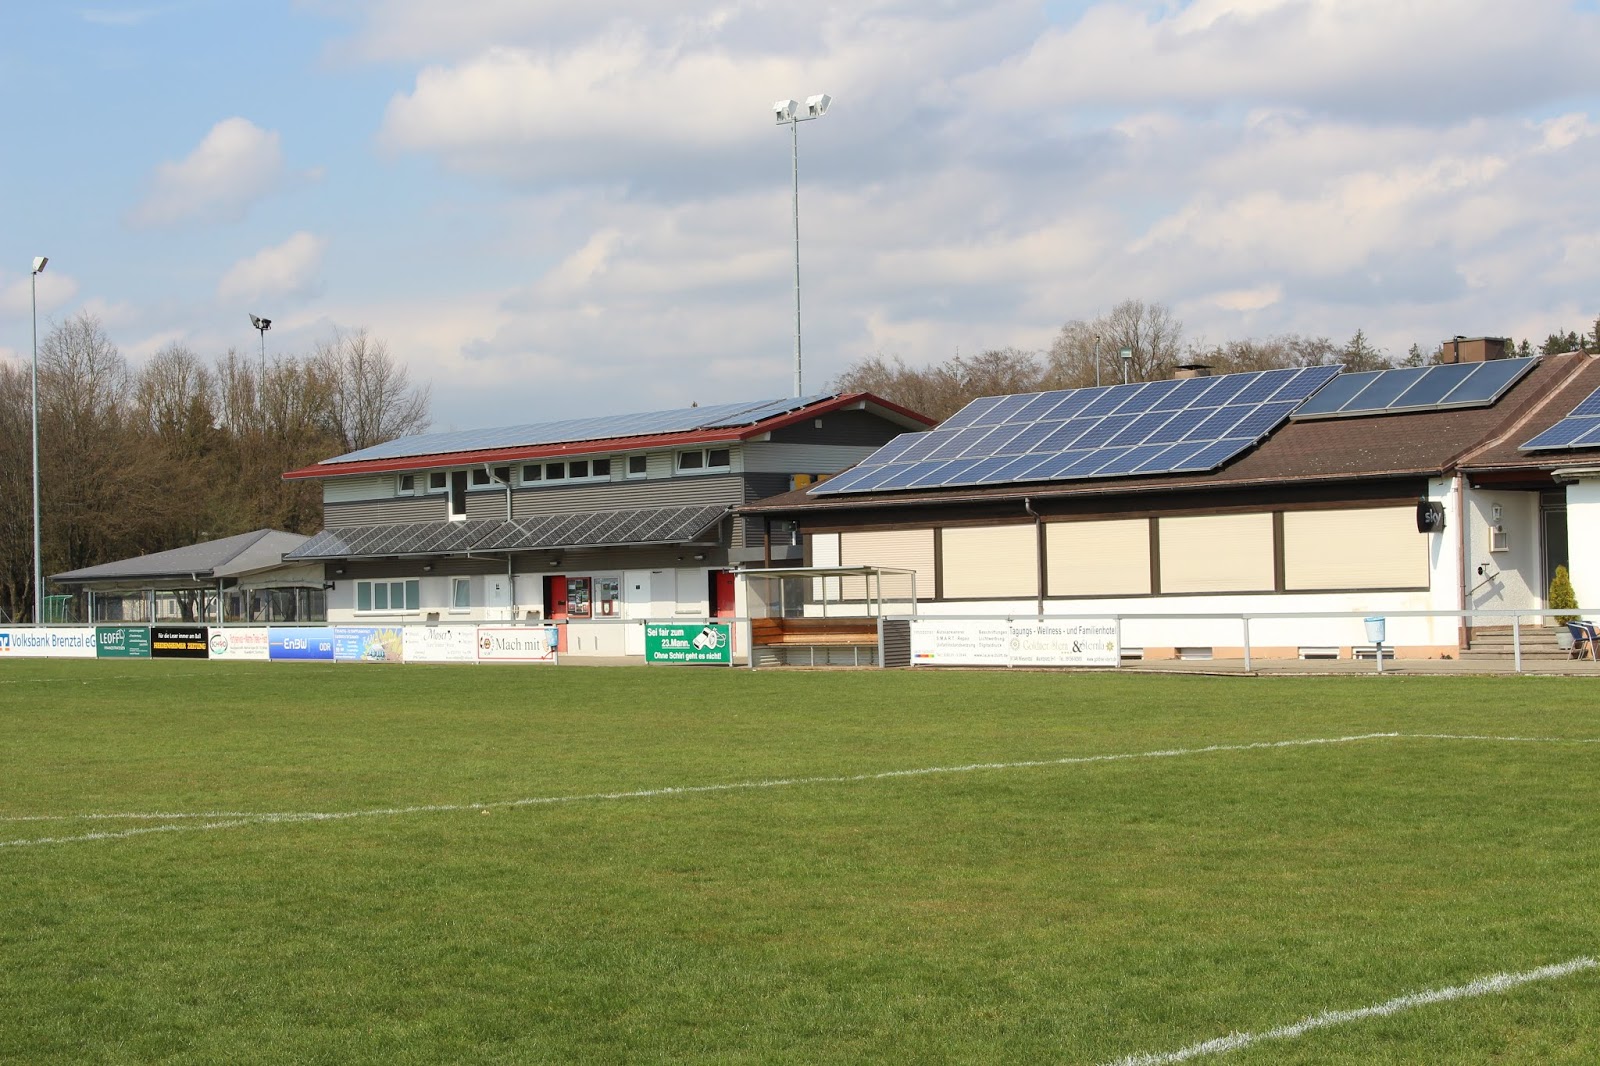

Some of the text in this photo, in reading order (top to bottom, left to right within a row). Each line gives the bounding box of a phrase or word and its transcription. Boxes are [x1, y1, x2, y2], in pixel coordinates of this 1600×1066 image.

[1425, 508, 1441, 526] sky
[647, 628, 684, 637] Sei fair zum
[1009, 626, 1033, 637] Tagungs
[1037, 626, 1062, 635] Wellness
[1067, 626, 1078, 635] und
[1079, 626, 1117, 635] Familienhotel
[11, 633, 96, 647] Volksbank Brenztal eG
[284, 638, 307, 649] EnBW
[495, 638, 523, 651] Mach
[525, 638, 540, 651] mit
[319, 643, 331, 651] ODR
[685, 652, 697, 661] geht
[706, 652, 722, 660] nicht!
